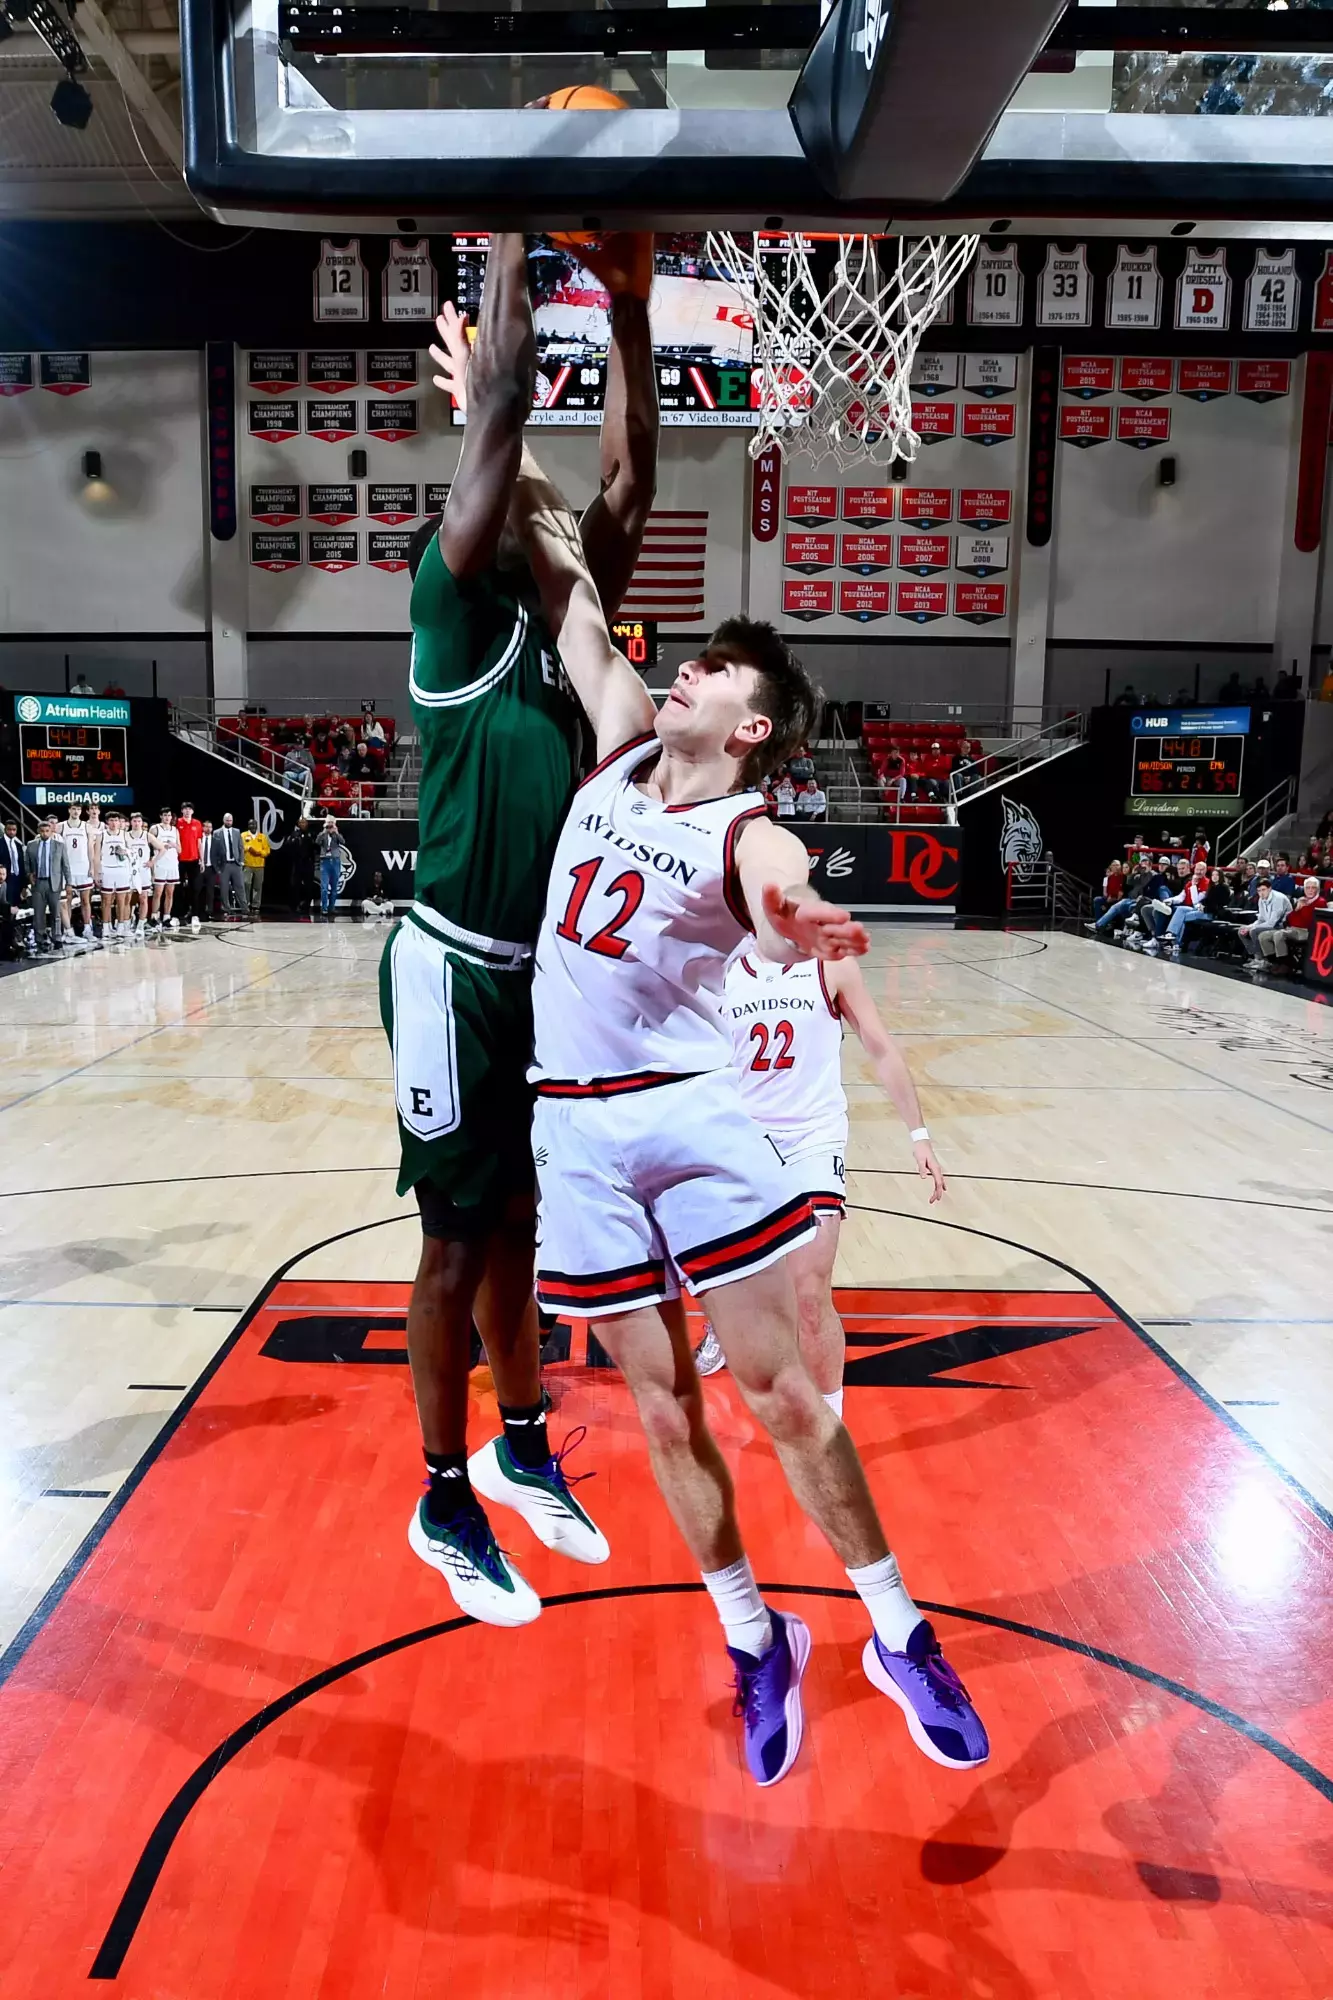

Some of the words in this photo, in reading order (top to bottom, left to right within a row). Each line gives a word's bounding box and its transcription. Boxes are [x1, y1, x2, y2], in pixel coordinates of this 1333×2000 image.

[458, 254, 466, 262] 12
[331, 270, 352, 293] 12
[400, 269, 420, 293] 31
[986, 273, 1007, 297] 10
[1052, 274, 1078, 298] 33
[1128, 276, 1143, 299] 11
[1260, 279, 1285, 303] 42
[1192, 288, 1214, 313] D
[254, 362, 294, 370] CHAMPIONS
[312, 362, 352, 370] CHAMPIONS
[371, 362, 412, 370] CHAMPIONS
[580, 368, 599, 385] 86
[660, 369, 681, 386] 59
[717, 371, 746, 406] E
[594, 396, 599, 405] 7
[686, 397, 695, 405] 10
[372, 410, 412, 418] CHAMPIONS
[530, 412, 554, 424] eryle
[559, 412, 578, 422] and
[584, 412, 602, 423] Joel
[689, 413, 718, 422] Video
[721, 413, 753, 423] Board
[256, 494, 296, 502] CHAMPIONS
[372, 493, 412, 501] CHAMPIONS
[256, 542, 296, 550] CHAMPIONS
[846, 544, 887, 552] TOURNAMENT
[385, 550, 401, 558] 2013
[790, 590, 827, 598] POSTSEASON
[613, 624, 643, 638] 44.8
[628, 638, 646, 662] 10
[46, 704, 89, 718] Atrium
[90, 705, 128, 719] Health
[1145, 717, 1169, 728] HUB
[72, 764, 79, 778] 2
[1181, 775, 1190, 789] 2
[1132, 798, 1180, 813] Davidson
[72, 838, 78, 849] 8
[578, 813, 698, 886] AVIDSON
[381, 850, 419, 871] WI
[886, 830, 959, 900] DC
[556, 856, 645, 961] 12
[731, 998, 815, 1020] DAVIDSON
[750, 1020, 796, 1071] 22
[409, 1086, 433, 1118] E
